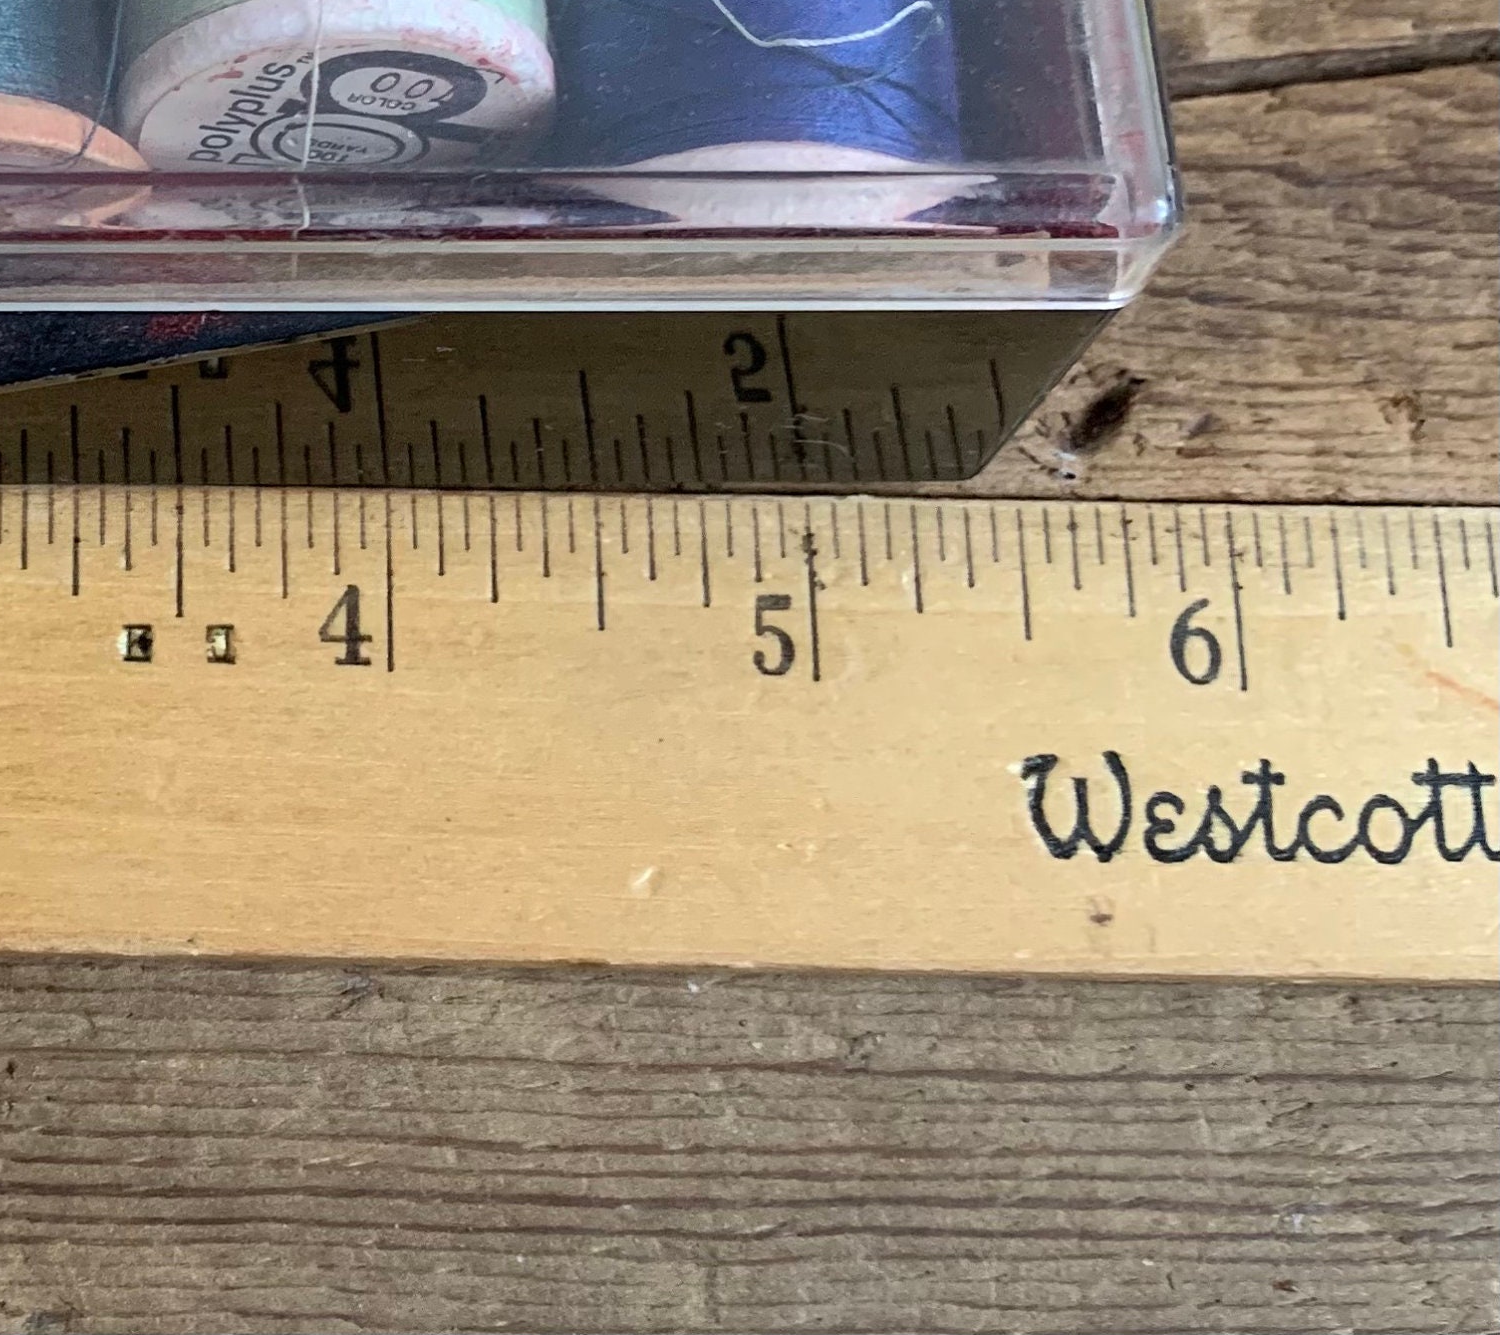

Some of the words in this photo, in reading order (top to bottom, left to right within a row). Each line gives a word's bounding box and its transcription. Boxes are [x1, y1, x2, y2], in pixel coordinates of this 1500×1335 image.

[318, 583, 373, 666] 4
[753, 593, 795, 676] 5
[1170, 598, 1222, 686] 6
[1020, 749, 1500, 864] Westcott
